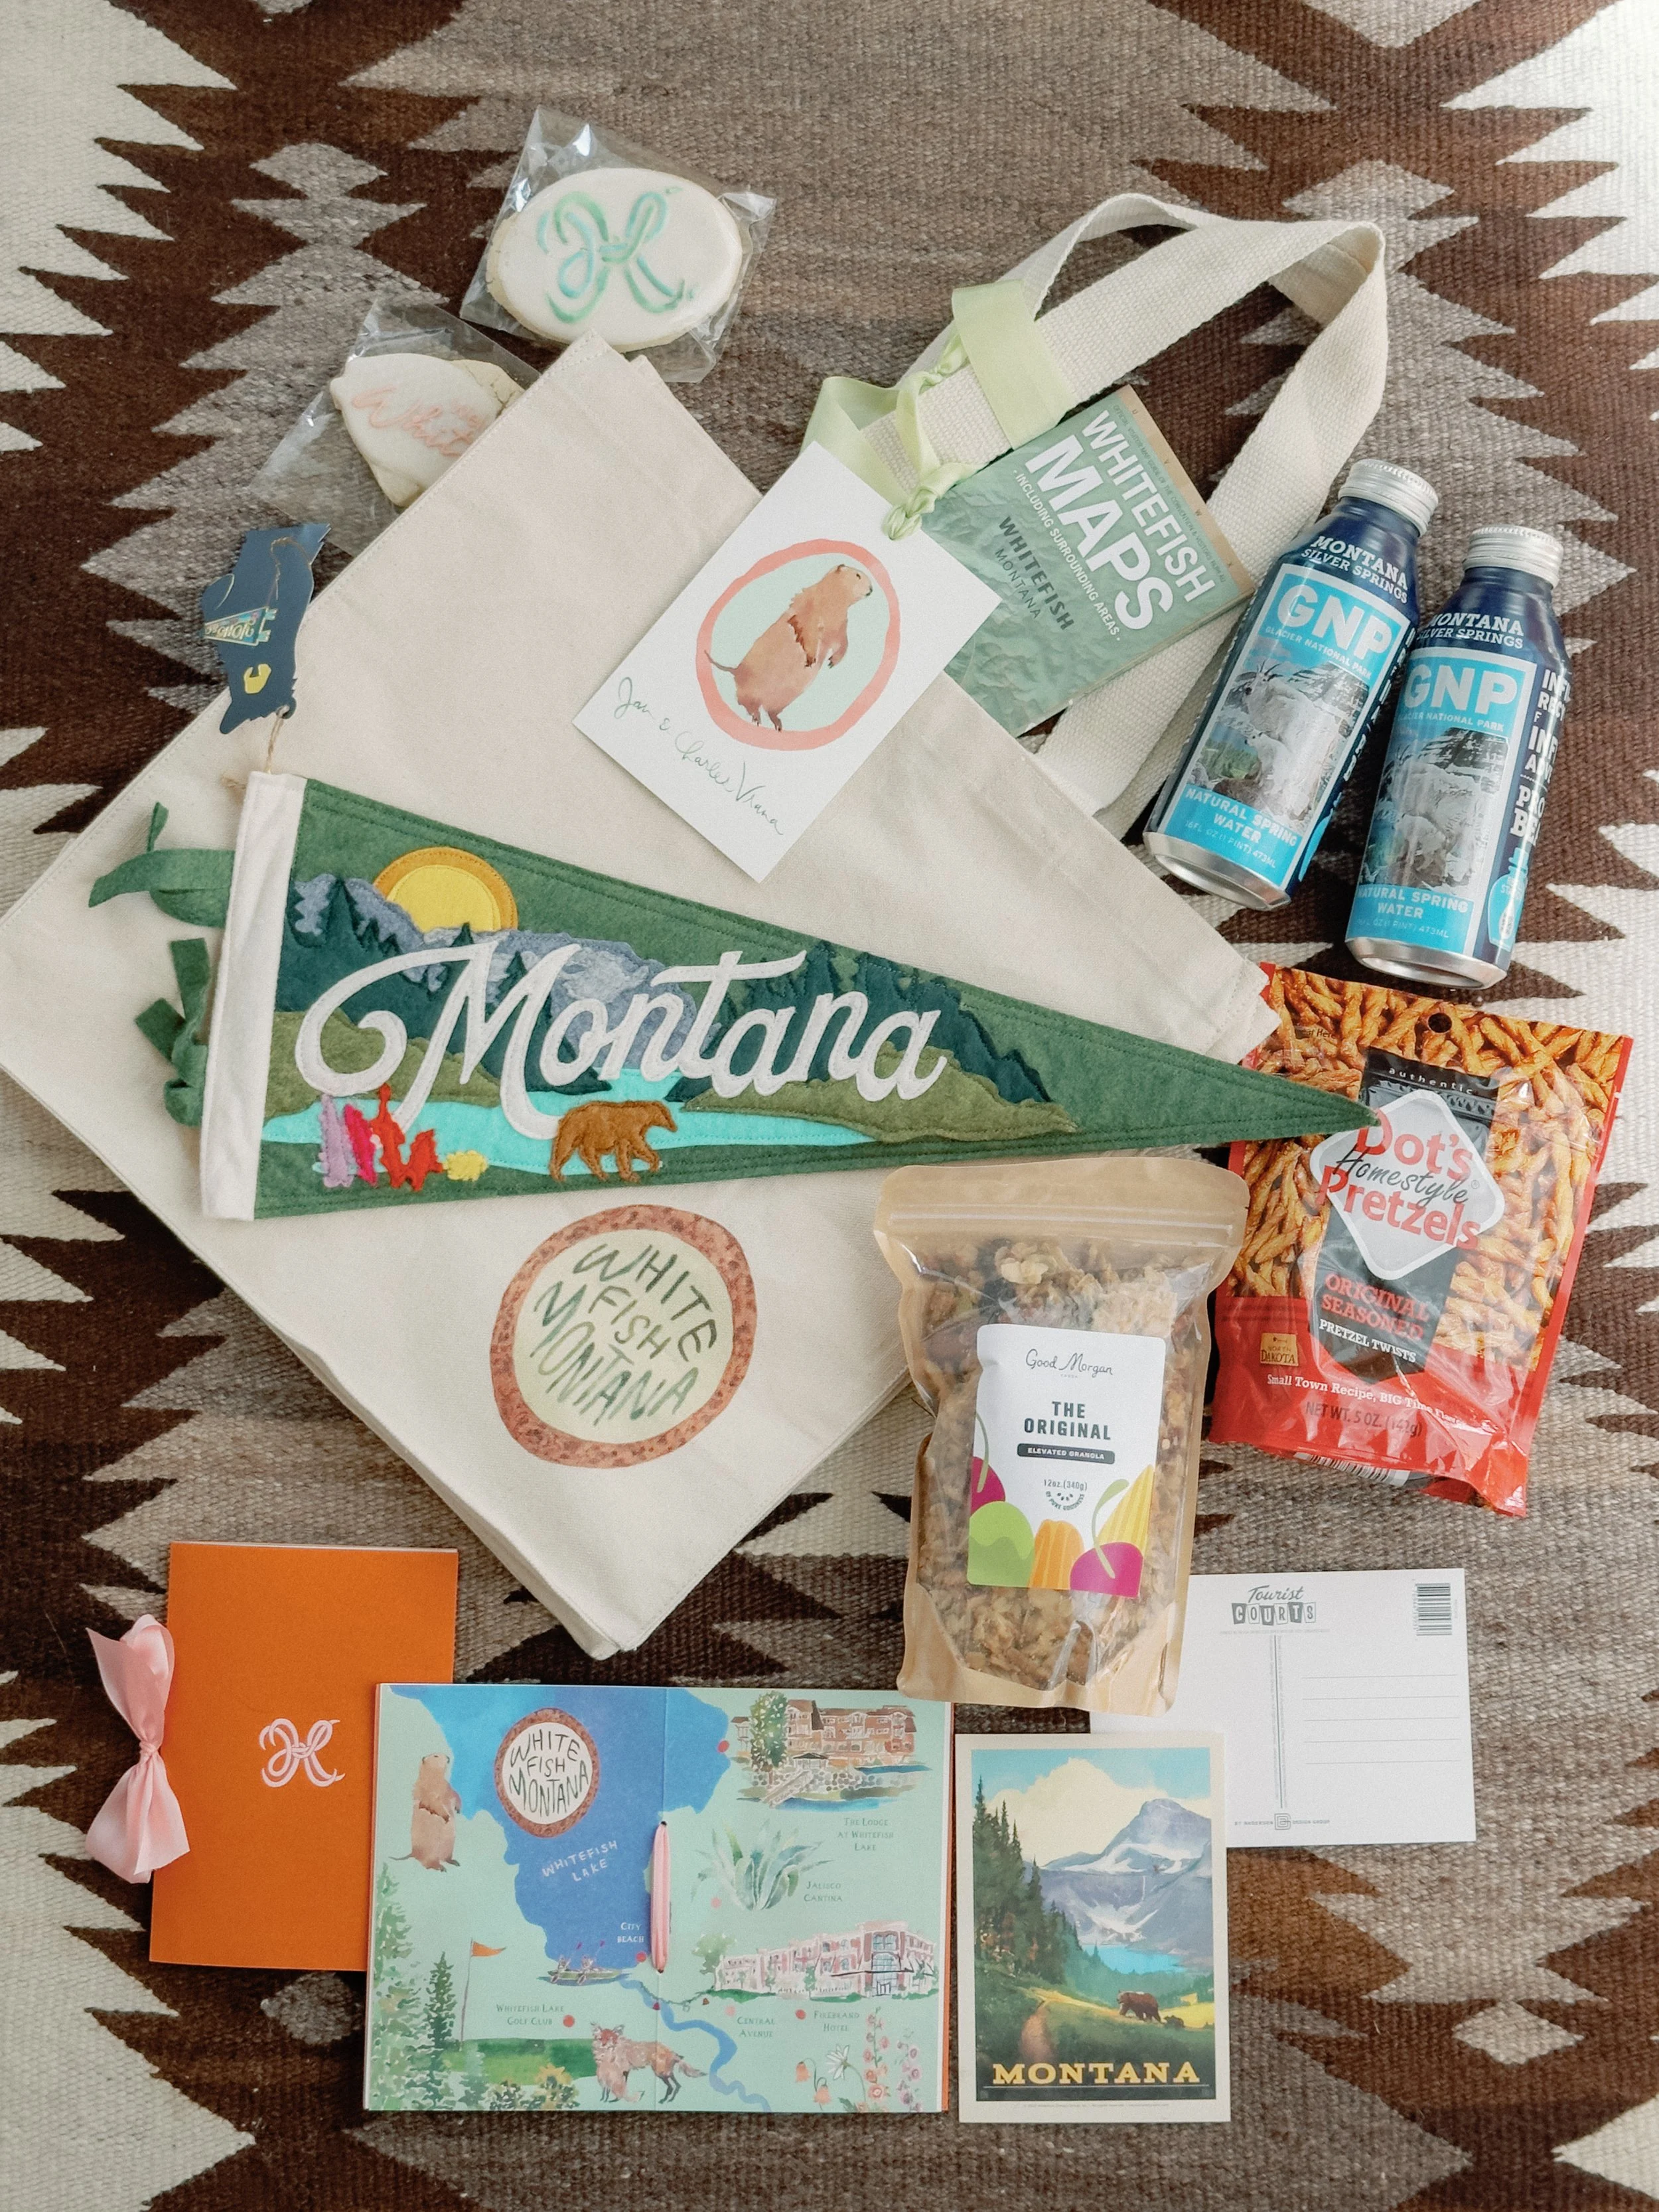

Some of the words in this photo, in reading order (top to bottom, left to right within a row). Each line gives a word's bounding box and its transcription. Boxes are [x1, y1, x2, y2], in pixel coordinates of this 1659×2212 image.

[1082, 409, 1215, 603] WHITEFISH
[1016, 473, 1052, 528] INCLUDING
[1048, 529, 1099, 601] SURROUNDING
[1094, 600, 1119, 635] AREAS
[1025, 435, 1174, 630] MAPS
[995, 548, 1041, 619] MONTANA
[998, 516, 1074, 630] WHITEFISH
[1301, 549, 1351, 571] SILVER
[1352, 565, 1407, 604] SPRINGS
[1311, 535, 1407, 591] MONTANA
[1277, 585, 1392, 660] GNP
[1456, 628, 1523, 648] SPRINGS
[1265, 626, 1302, 644] GLACIER
[1305, 640, 1350, 664] NATIONAL
[1352, 662, 1372, 680] PARK
[1404, 664, 1518, 715] GNP
[1427, 712, 1473, 725] NATIONAL
[1477, 719, 1504, 732] PARK
[1185, 788, 1247, 820] NATURAL
[1252, 814, 1297, 847] SPRING
[1213, 813, 1262, 844] WATER
[1377, 902, 1424, 919] WATER
[1411, 891, 1469, 913] SPRING
[294, 938, 948, 1142] Montana
[1388, 1067, 1474, 1095] authentic
[1352, 1108, 1474, 1181] Dot's
[1331, 1142, 1469, 1209] Homestyle
[1315, 1165, 1481, 1250] Pretzels
[573, 1241, 717, 1363] WHITE
[1321, 1294, 1425, 1341] SEASONED
[1325, 1274, 1432, 1321] ORIGINAL
[589, 1285, 680, 1361] FISH
[1319, 1318, 1370, 1349] PRETZEL
[1371, 1339, 1417, 1363] TWISTS
[528, 1280, 701, 1426] MONTANA
[1025, 1348, 1058, 1370] Good
[1058, 1352, 1114, 1378] Morgan
[1260, 1349, 1297, 1364] DAKOTA
[1052, 1400, 1086, 1419] THE
[1267, 1374, 1293, 1386] Small
[1295, 1376, 1328, 1392] Town
[1331, 1382, 1377, 1403] Recipe,
[1380, 1392, 1404, 1406] BIG
[1024, 1418, 1112, 1441] ORIGINAL
[1305, 1401, 1329, 1419] NET
[1329, 1406, 1351, 1422] WT.
[1353, 1410, 1362, 1424] 5
[1364, 1412, 1382, 1428] OZ.
[1027, 1447, 1067, 1457] ELEVATED
[1068, 1450, 1105, 1460] GRANOLA
[1043, 1479, 1062, 1488] 12oz
[1063, 1479, 1088, 1491] (340g)
[1232, 1602, 1316, 1625] COURTS
[1248, 1584, 1305, 1603] Tourist
[510, 1728, 581, 1768] WHITE
[526, 1755, 566, 1778] FISH
[508, 1760, 589, 1818] MONTANA
[541, 1840, 618, 1878] WHITEFISH
[571, 1858, 609, 1882] LAKE
[992, 2061, 1201, 2086] MONTANA
